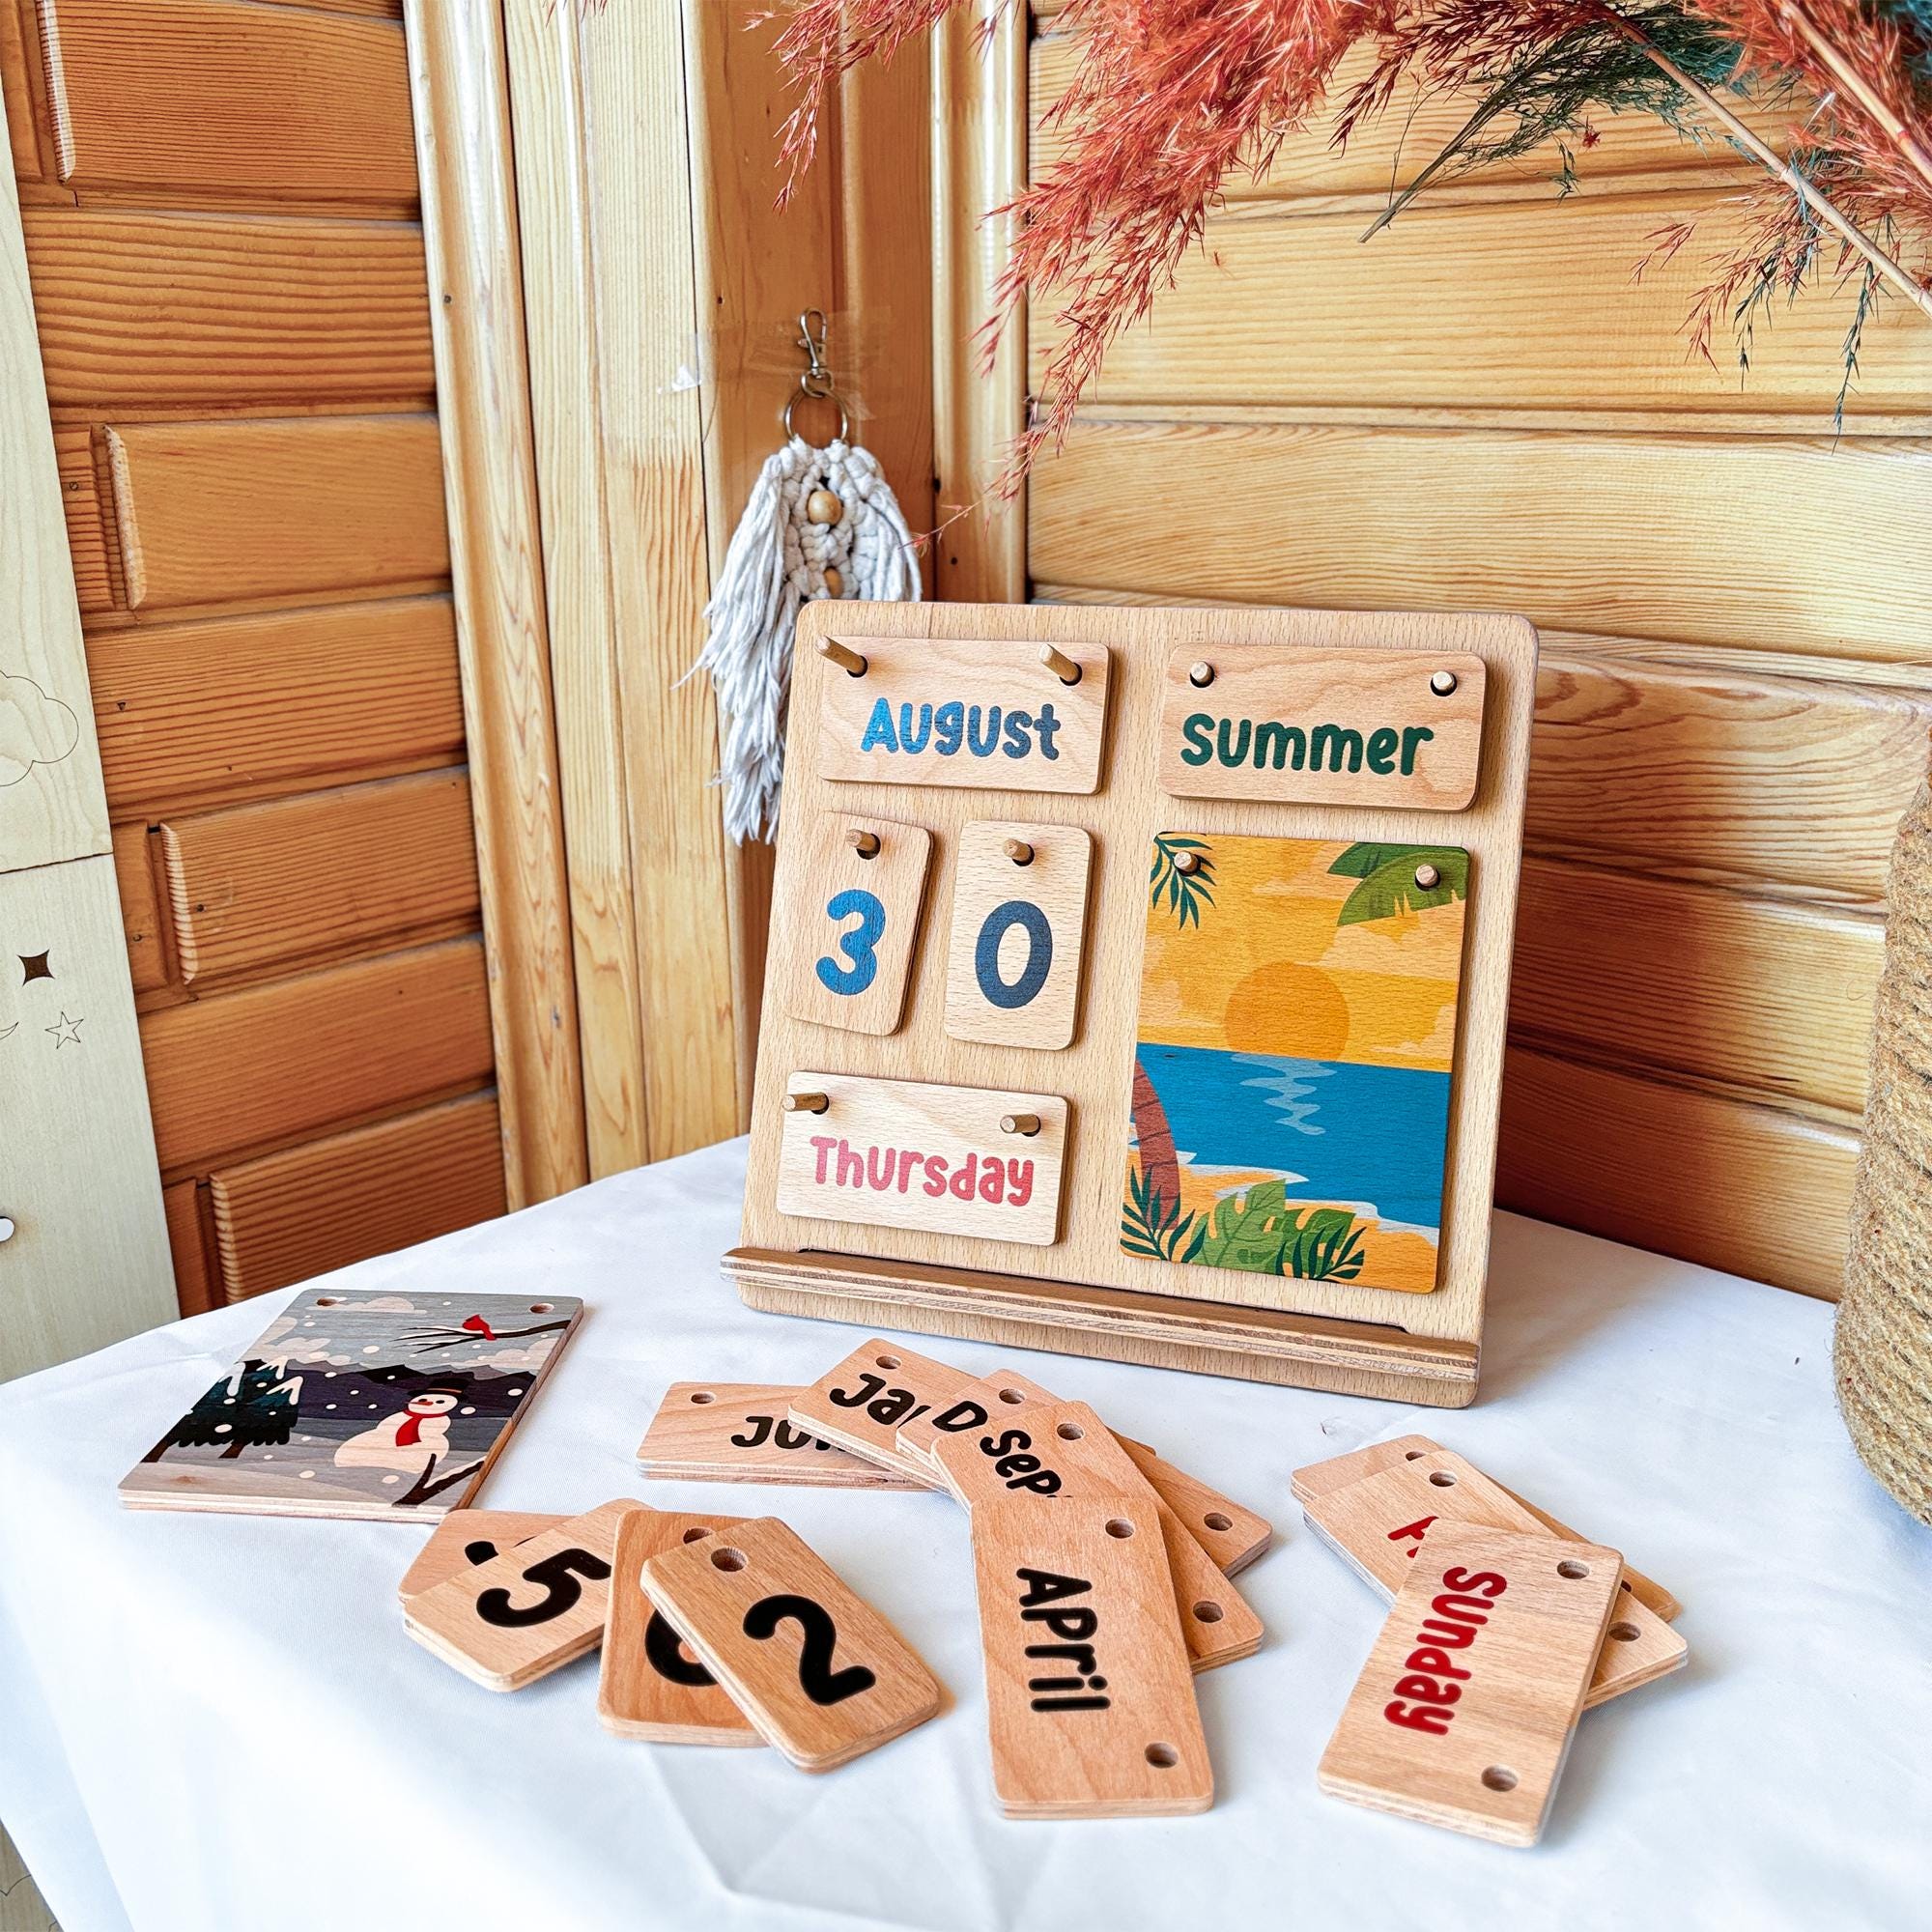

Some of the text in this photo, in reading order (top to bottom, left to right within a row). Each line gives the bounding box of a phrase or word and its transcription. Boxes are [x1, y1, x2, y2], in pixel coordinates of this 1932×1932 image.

[859, 696, 1061, 760] August
[1180, 713, 1435, 776] Summer
[815, 889, 1053, 1009] 3 0
[810, 1136, 1036, 1207] Thursday
[979, 1429, 1073, 1498] Sep
[475, 1547, 612, 1629] 5
[742, 1593, 877, 1707] 2
[1015, 1567, 1112, 1713] April
[1383, 1565, 1508, 1737] Sunday
